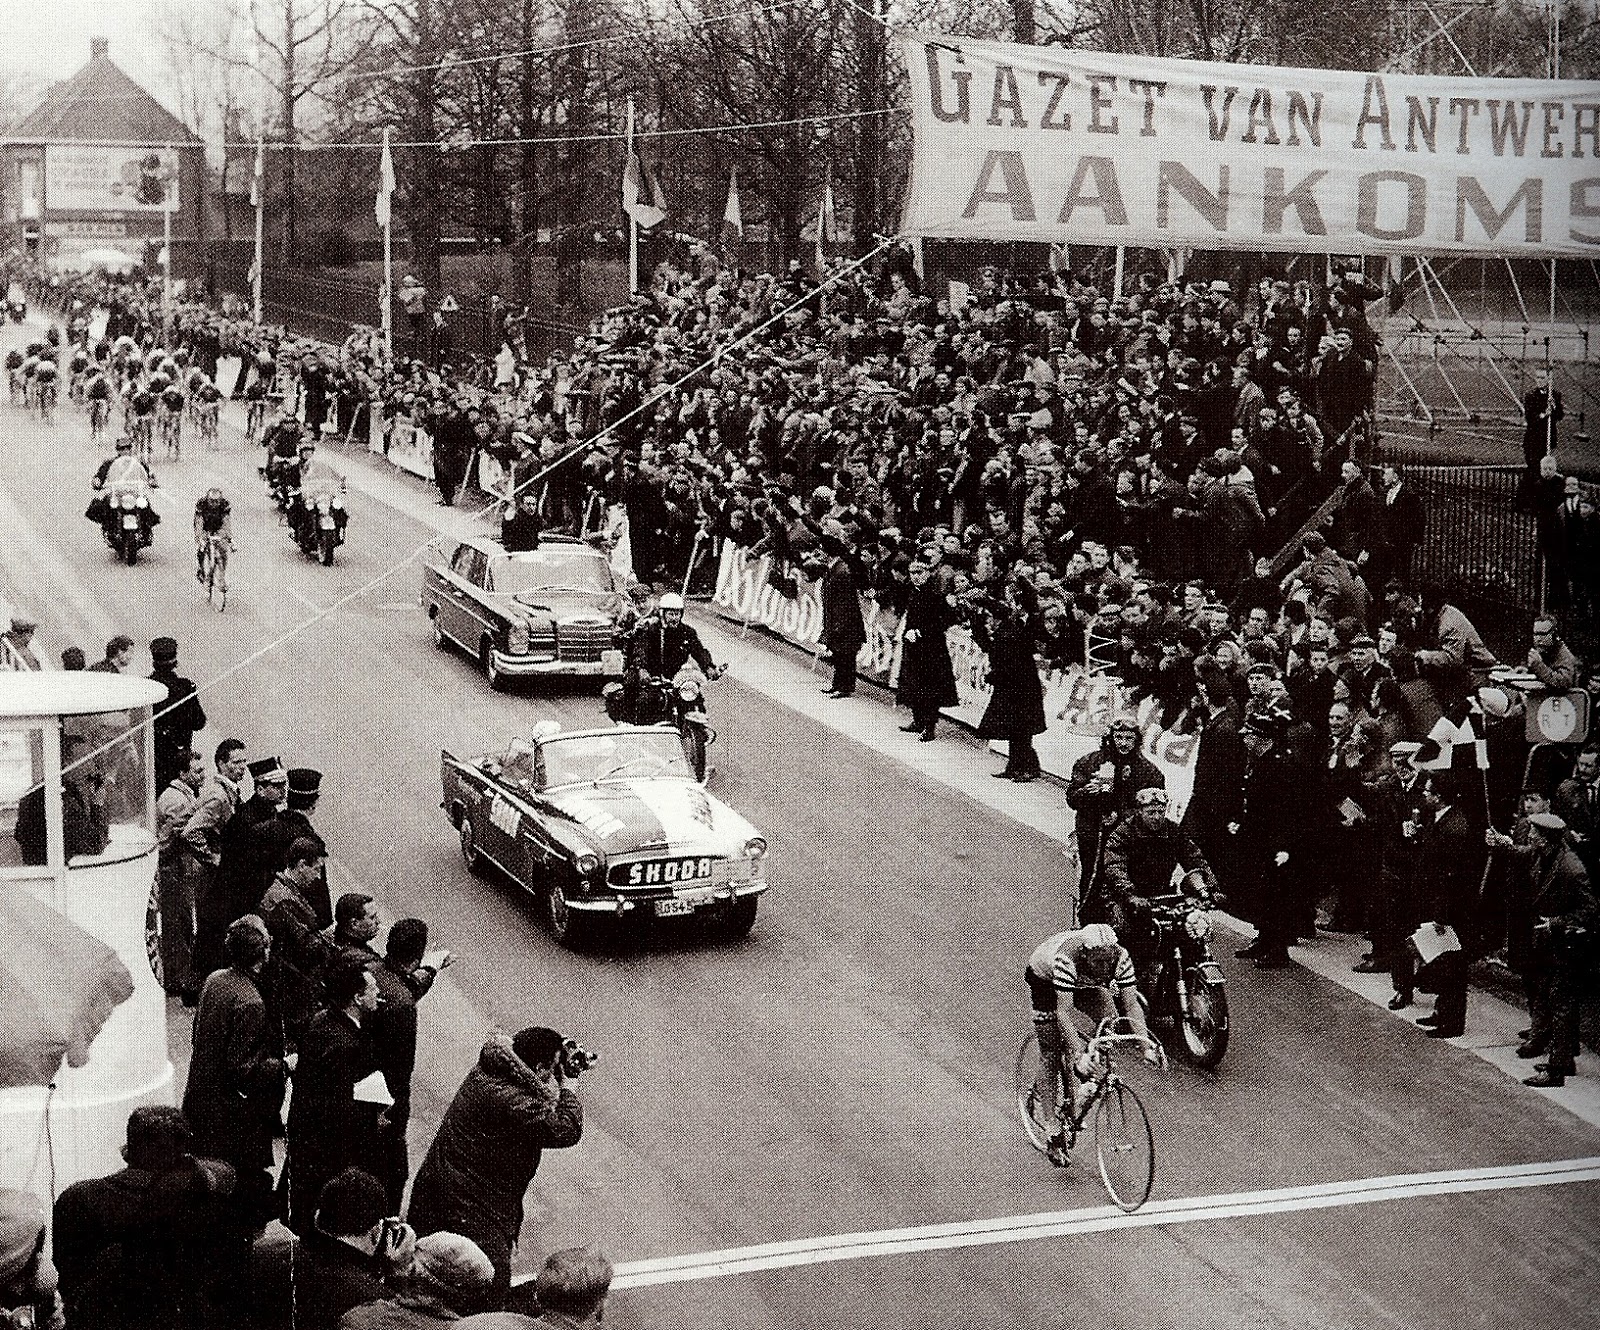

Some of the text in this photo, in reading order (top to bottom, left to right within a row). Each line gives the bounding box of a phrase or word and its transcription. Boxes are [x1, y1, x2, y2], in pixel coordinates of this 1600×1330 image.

[924, 43, 1600, 158] GAZET VAN ANTWER
[629, 858, 711, 884] SKODA
